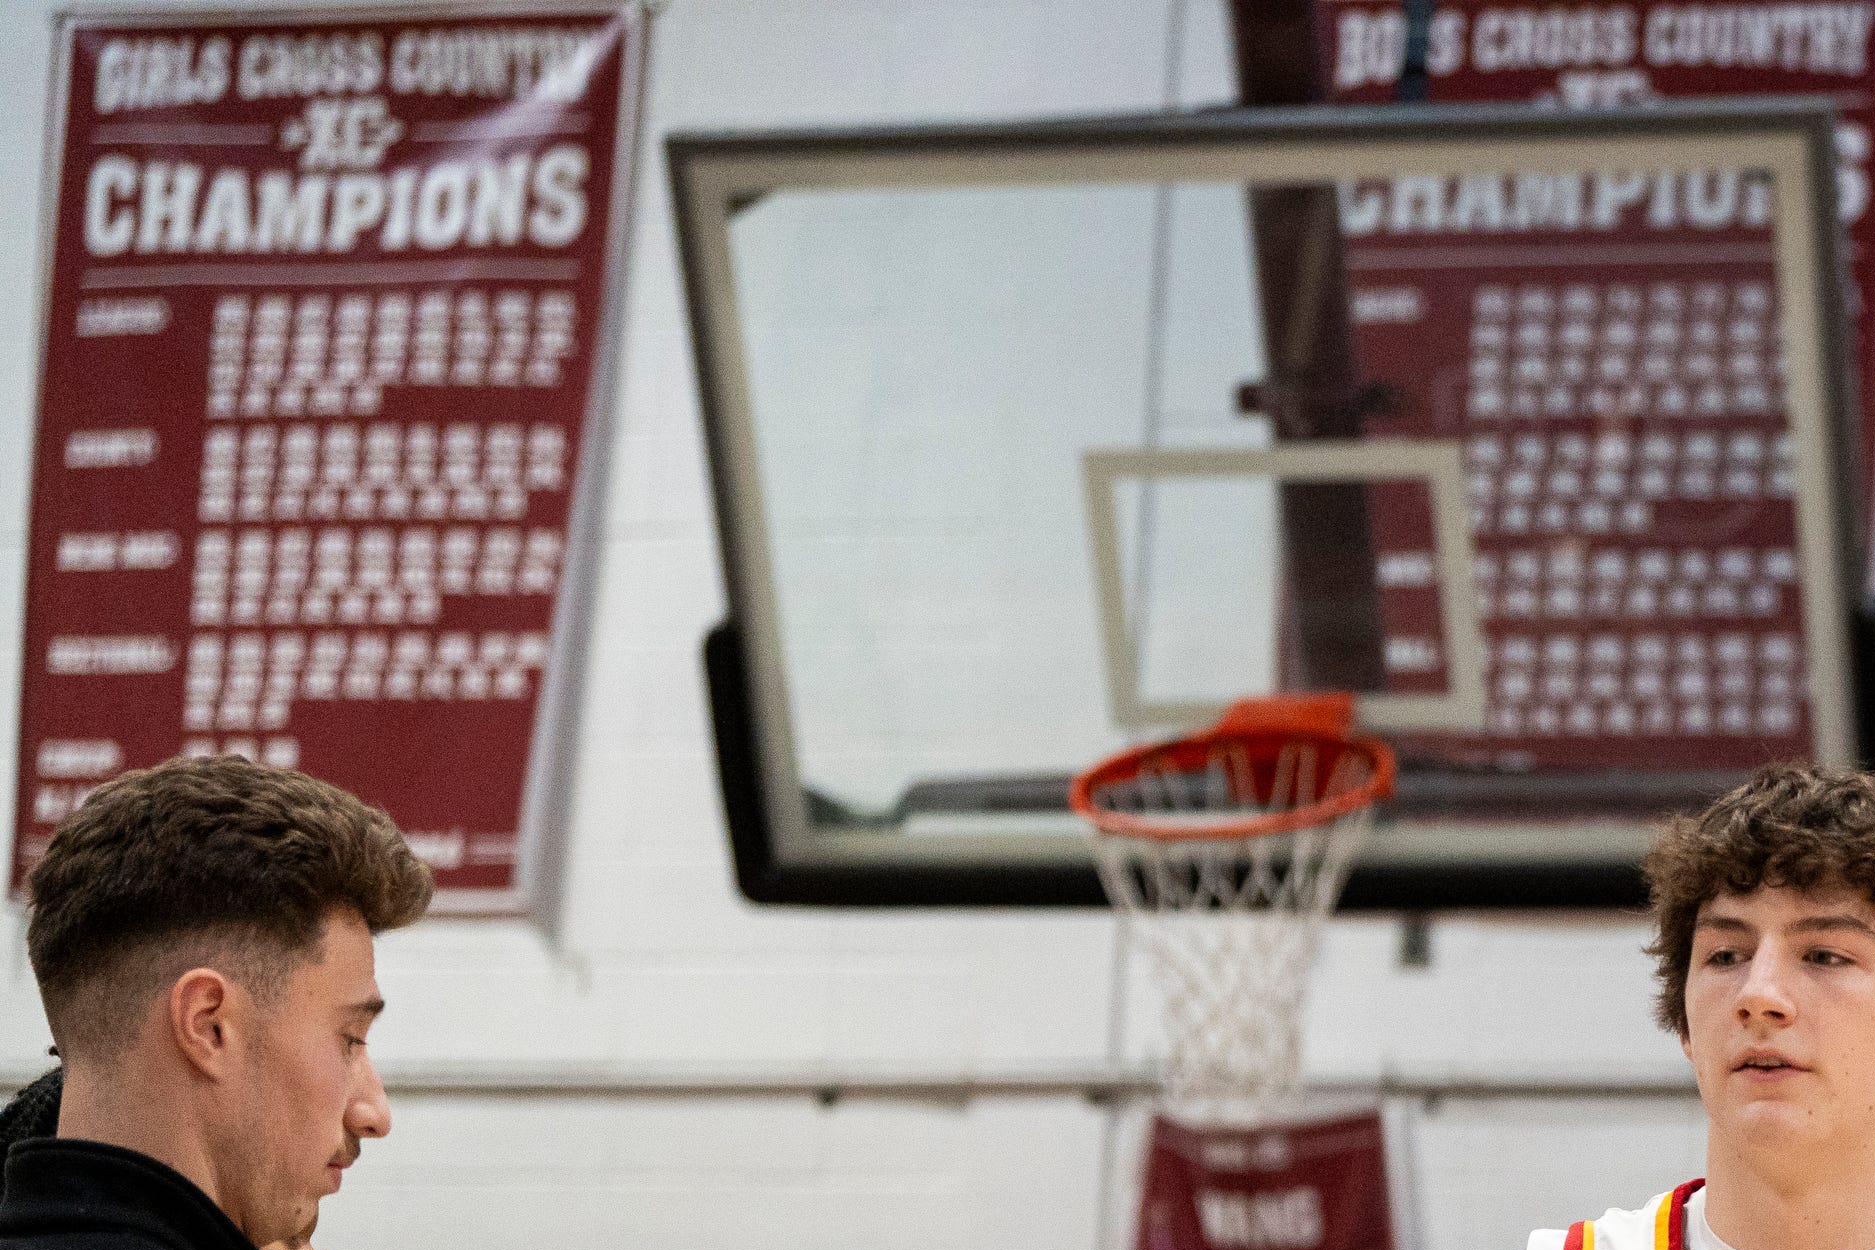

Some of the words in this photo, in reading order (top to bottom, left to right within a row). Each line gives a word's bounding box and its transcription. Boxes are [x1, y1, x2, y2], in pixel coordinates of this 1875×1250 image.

[97, 33, 232, 112] GIRLS
[236, 31, 385, 98] CROSS
[1335, 9, 1466, 88] BOS
[1471, 7, 1639, 71] CROSS
[1645, 5, 1875, 76] COUNTRY
[84, 146, 593, 257] CHAMPIONS
